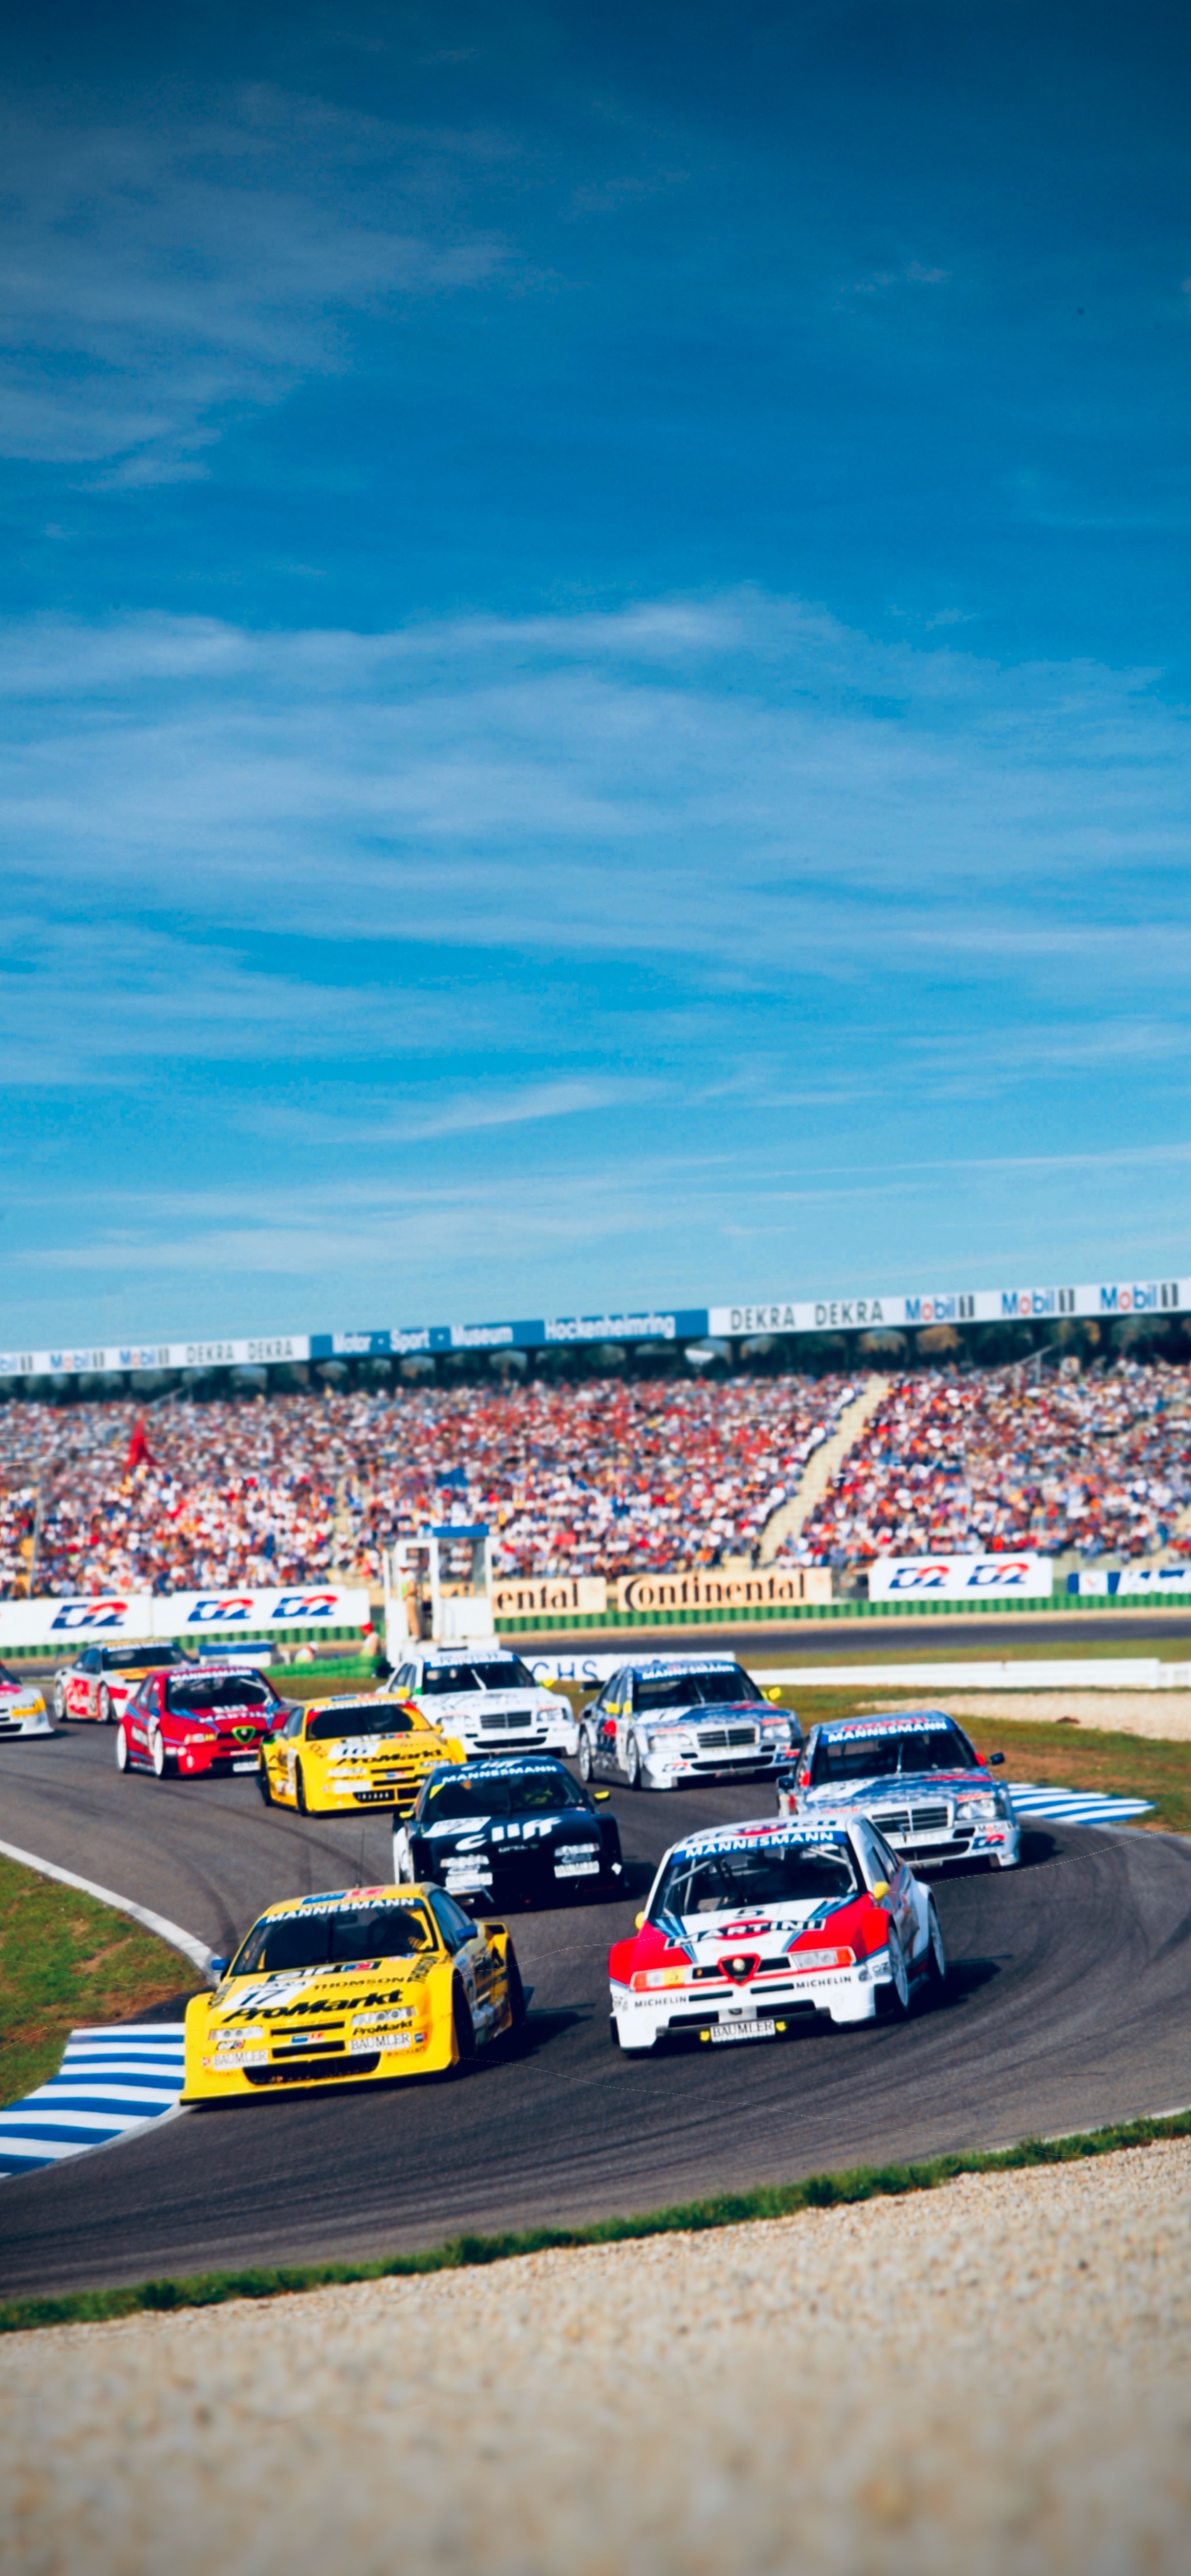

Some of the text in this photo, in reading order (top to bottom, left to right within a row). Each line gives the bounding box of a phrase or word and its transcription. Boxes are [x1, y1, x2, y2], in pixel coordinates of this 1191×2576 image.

[905, 1295, 956, 1321] Mobil
[1002, 1290, 1055, 1316] Mobil
[1100, 1285, 1157, 1310] Mobil
[544, 1314, 676, 1340] Hockenheimring
[731, 1300, 884, 1331] DEKRA DEKRA
[187, 1340, 294, 1363] DEKRA DEKRA
[389, 1328, 430, 1355] Sport
[449, 1324, 513, 1347] Museum
[625, 1573, 805, 1611] Continental
[532, 1659, 598, 1680] CHS
[827, 1721, 947, 1743] MANNESMANN
[442, 1765, 557, 1783] MANNESMANN
[685, 1831, 834, 1858] MANNESMANN
[266, 1898, 415, 1924] MANNESMANN
[671, 1919, 820, 1948] MARTINI
[315, 1977, 405, 1990] THOMSON
[795, 1975, 852, 1990] MICHELIN
[221, 1988, 404, 2023] ProMarkt
[238, 1989, 288, 2006] 17
[634, 1996, 687, 2008] MICHELIN
